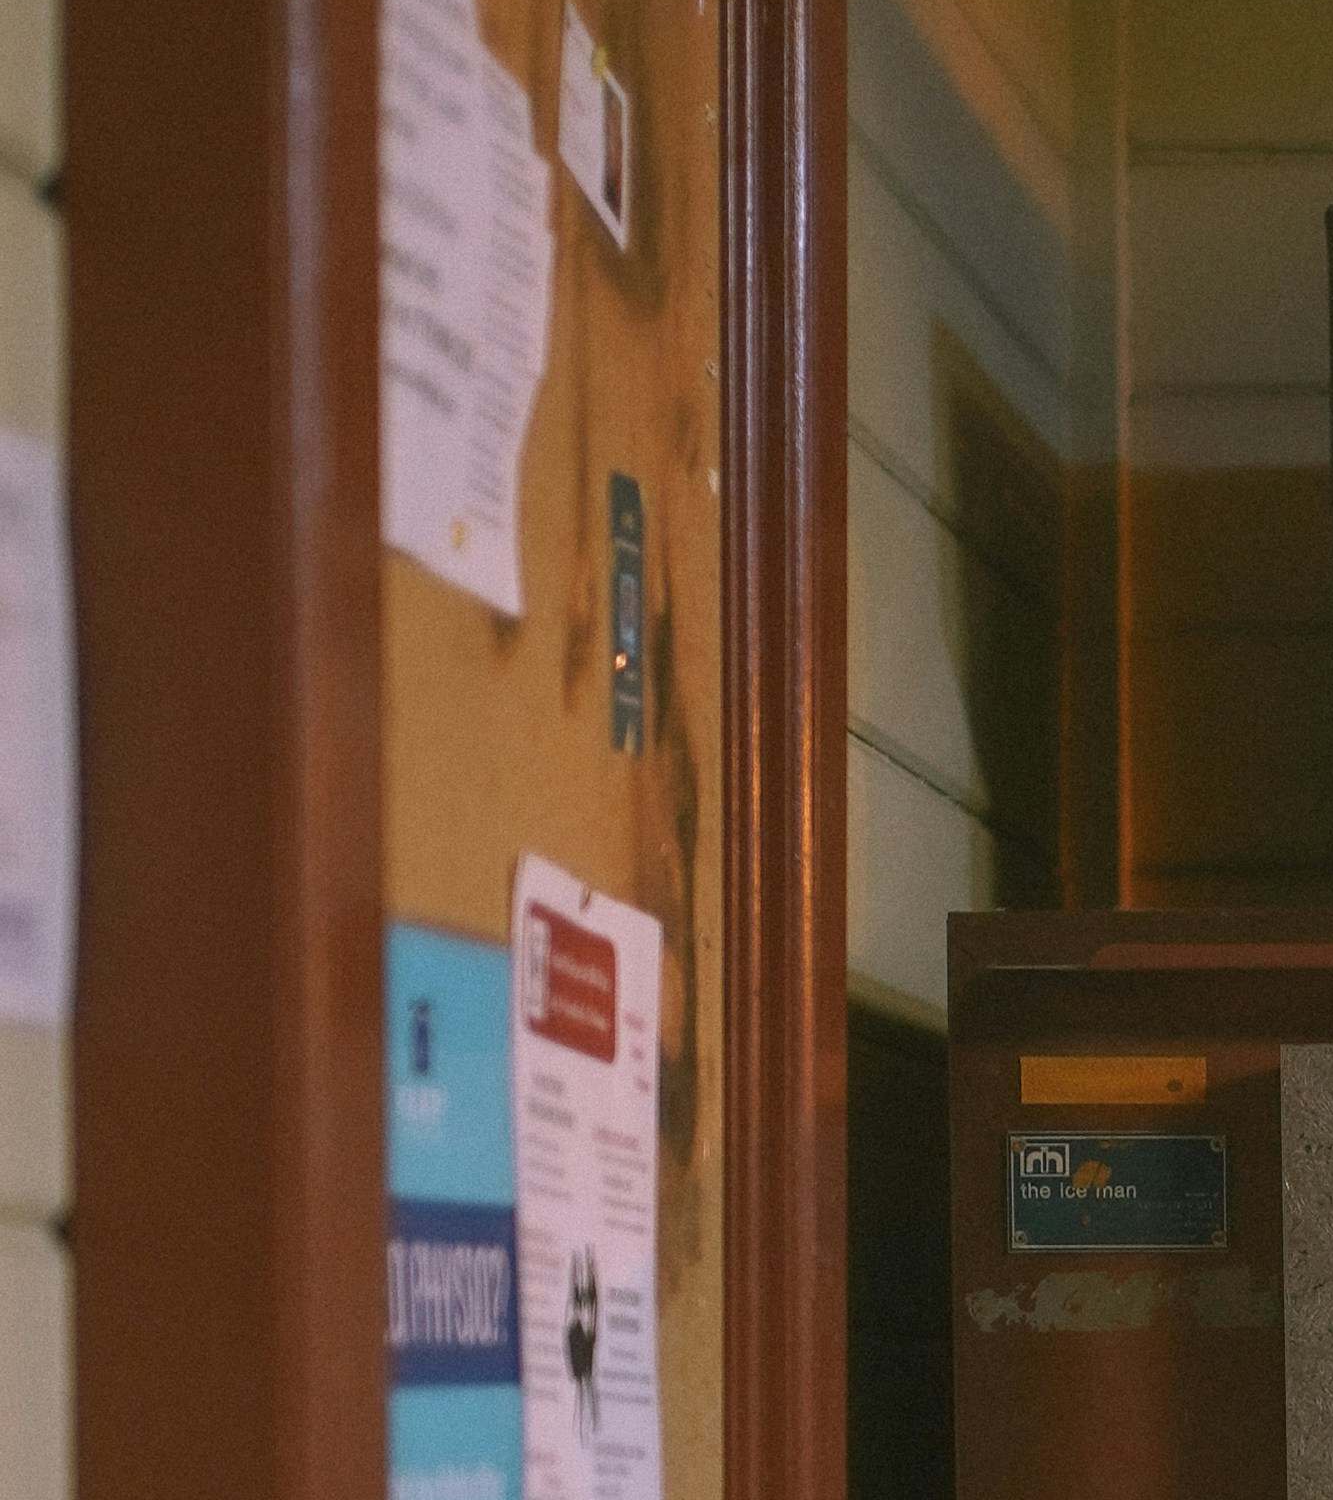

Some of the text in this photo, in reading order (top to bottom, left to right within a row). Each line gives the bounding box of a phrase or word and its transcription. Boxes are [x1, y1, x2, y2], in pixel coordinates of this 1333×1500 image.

[1019, 1181, 1051, 1200] the
[1059, 1181, 1088, 1200] ice
[1095, 1183, 1138, 1200] man
